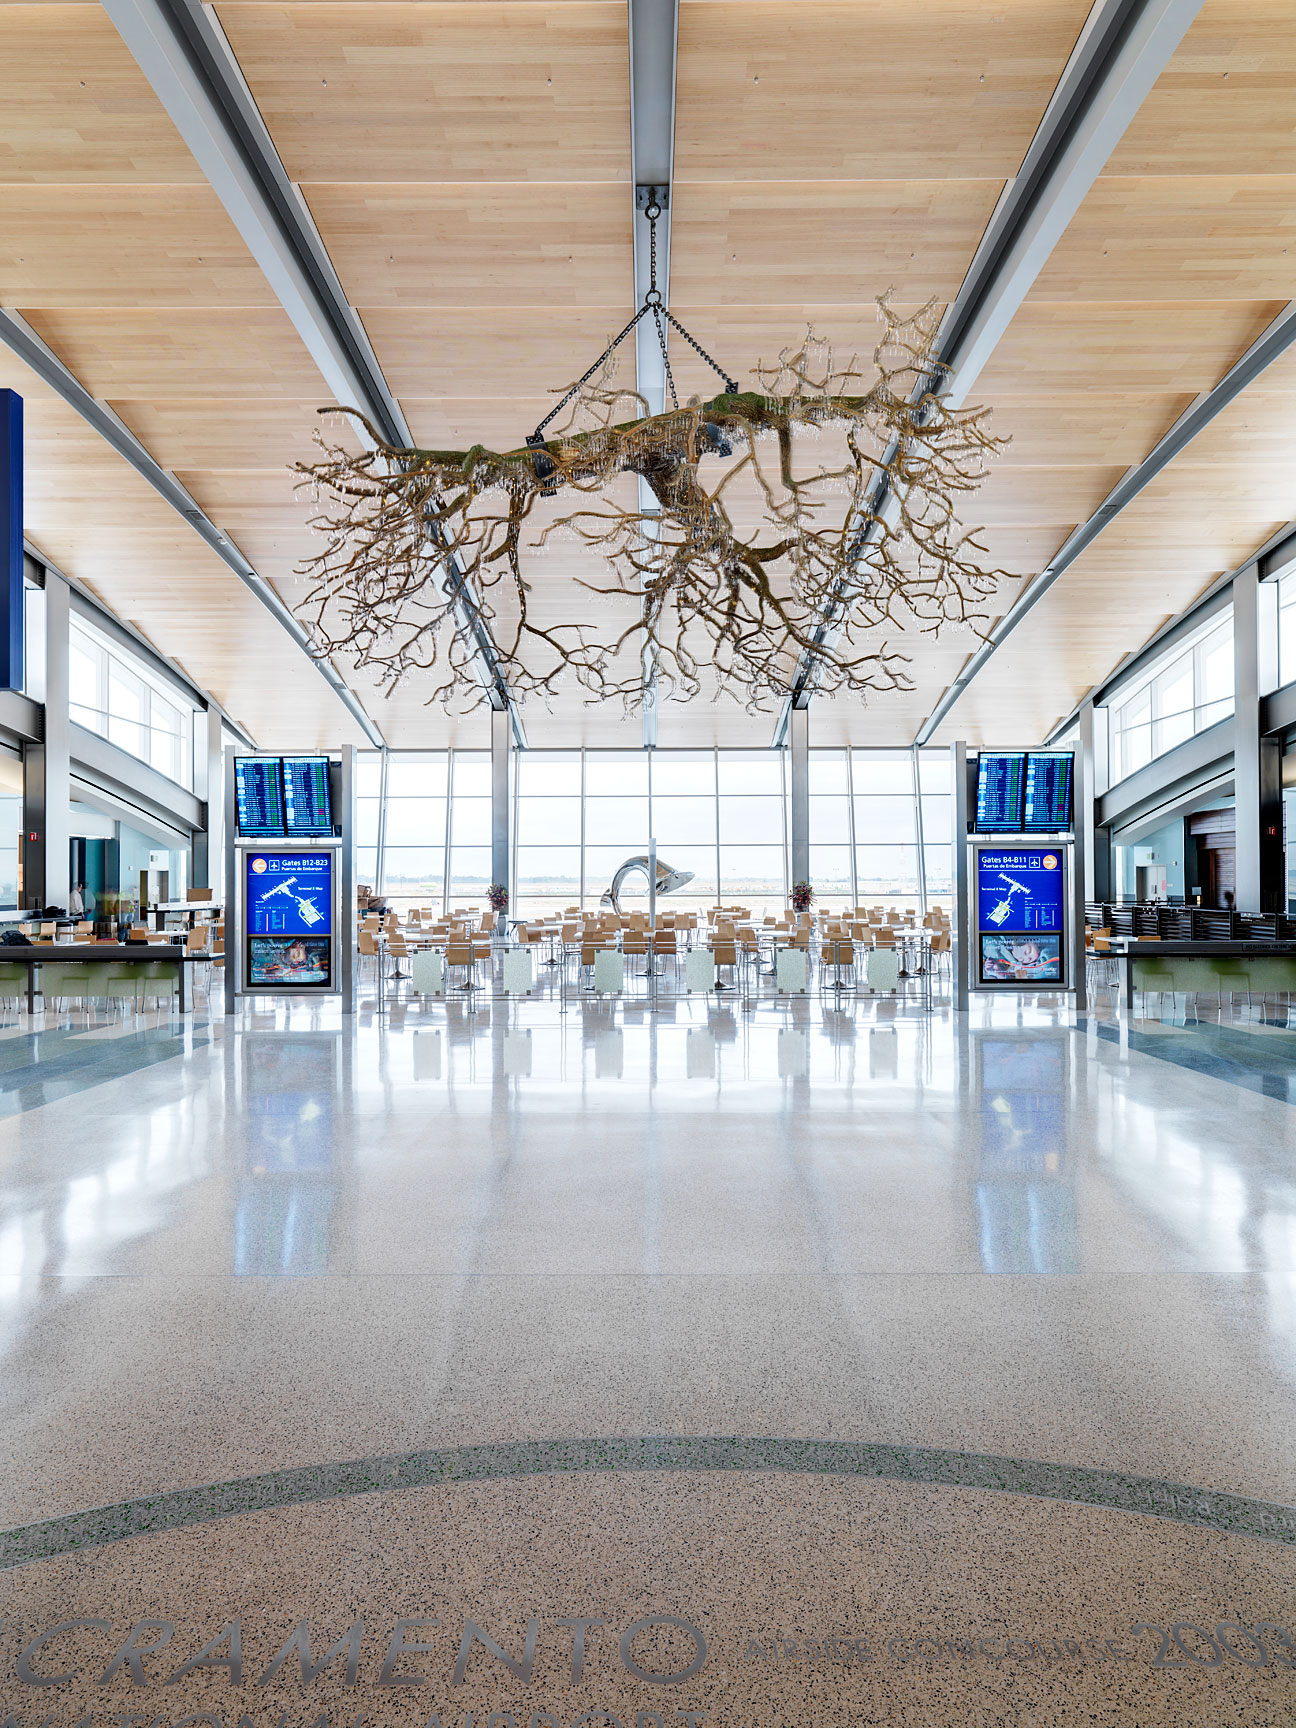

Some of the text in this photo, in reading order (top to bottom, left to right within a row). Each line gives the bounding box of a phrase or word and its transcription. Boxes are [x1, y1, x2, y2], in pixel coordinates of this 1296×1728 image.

[16, 1616, 707, 1686] CRAMENTO
[744, 1638, 874, 1662] AIRSIDE
[887, 1638, 1131, 1662] CONCOURSE
